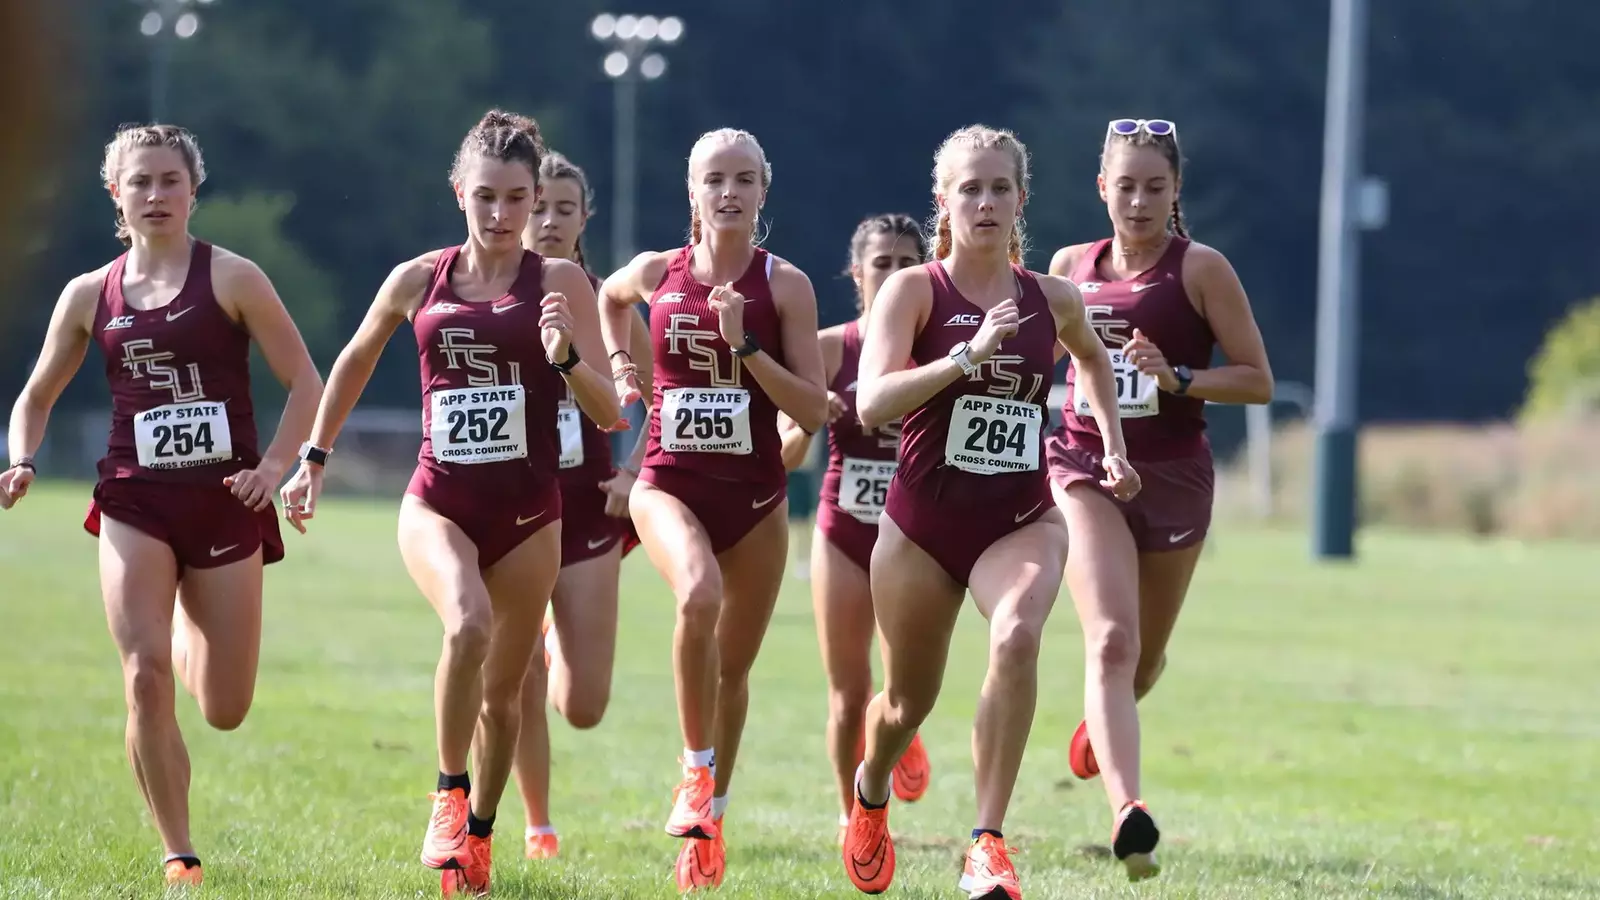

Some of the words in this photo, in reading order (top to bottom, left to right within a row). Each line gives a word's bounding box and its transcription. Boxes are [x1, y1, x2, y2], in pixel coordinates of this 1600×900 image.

[426, 302, 461, 314] ACC
[103, 315, 135, 331] ACC
[943, 314, 981, 327] ACC
[664, 313, 743, 387] FSU
[121, 338, 207, 403] FSU
[439, 393, 467, 407] APP
[471, 390, 517, 404] STATE
[698, 393, 741, 403] STATE
[143, 408, 172, 422] APP
[176, 406, 218, 419] STATE
[962, 399, 993, 413] APP
[995, 403, 1036, 419] STATE
[447, 407, 510, 444] 252
[674, 408, 734, 440] 255
[152, 422, 214, 458] 254
[964, 416, 1027, 457] 264
[442, 447, 473, 458] CROSS
[475, 444, 519, 455] COUNTRY
[668, 443, 698, 451] CROSS
[700, 441, 743, 451] COUNTRY
[179, 455, 224, 467] COUNTRY
[953, 453, 986, 466] CROSS
[987, 458, 1031, 471] COUNTRY
